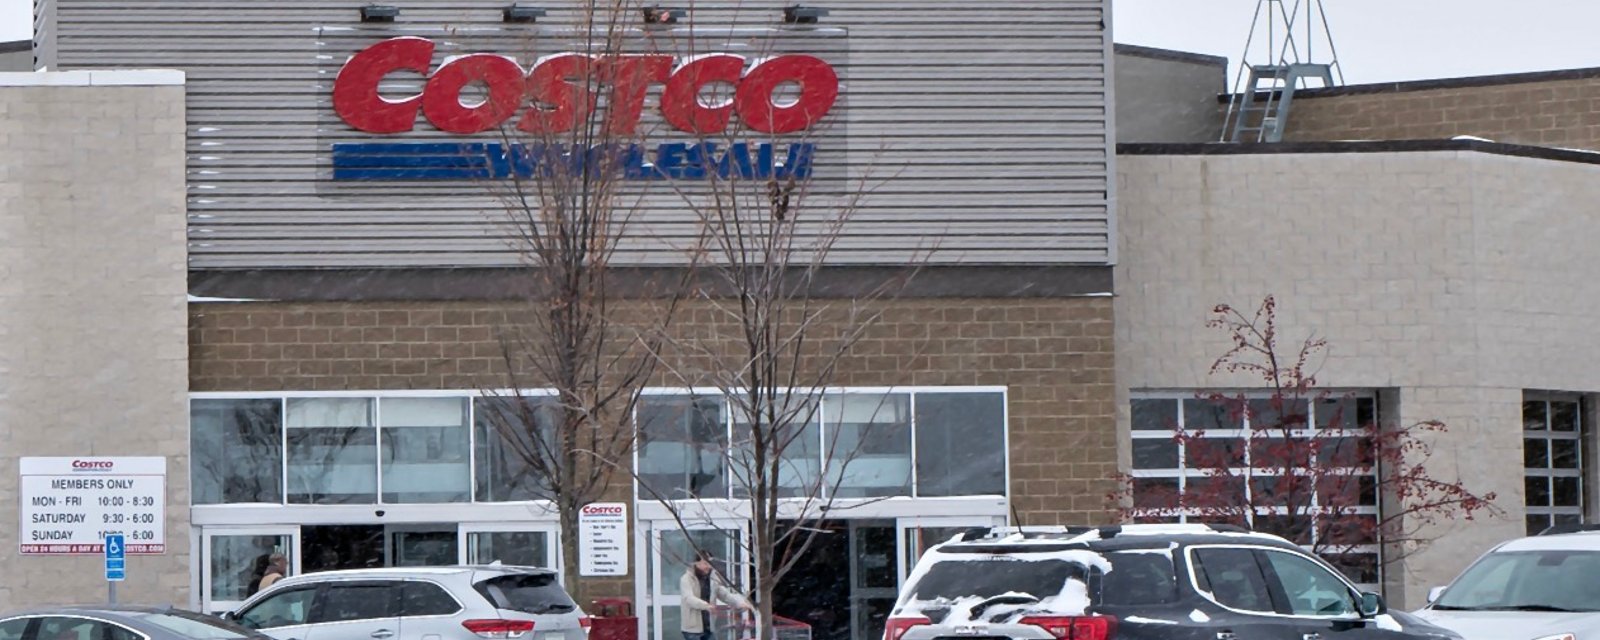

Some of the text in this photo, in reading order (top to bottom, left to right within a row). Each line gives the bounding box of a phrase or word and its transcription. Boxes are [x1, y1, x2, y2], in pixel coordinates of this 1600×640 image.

[333, 36, 838, 134] COSTCO
[72, 460, 113, 468] COSTCO
[52, 480, 134, 489] MEMBERS ONLY
[32, 497, 56, 506] MON
[65, 497, 82, 506] FRI
[98, 497, 124, 506] 10:00
[132, 497, 154, 506] 8:30
[582, 506, 622, 514] COSTCO
[32, 514, 86, 523] SATURDAY
[103, 514, 124, 523] 9:30
[132, 514, 154, 523] 6:00
[32, 530, 73, 540] SUNDAY
[132, 530, 154, 540] 6:00
